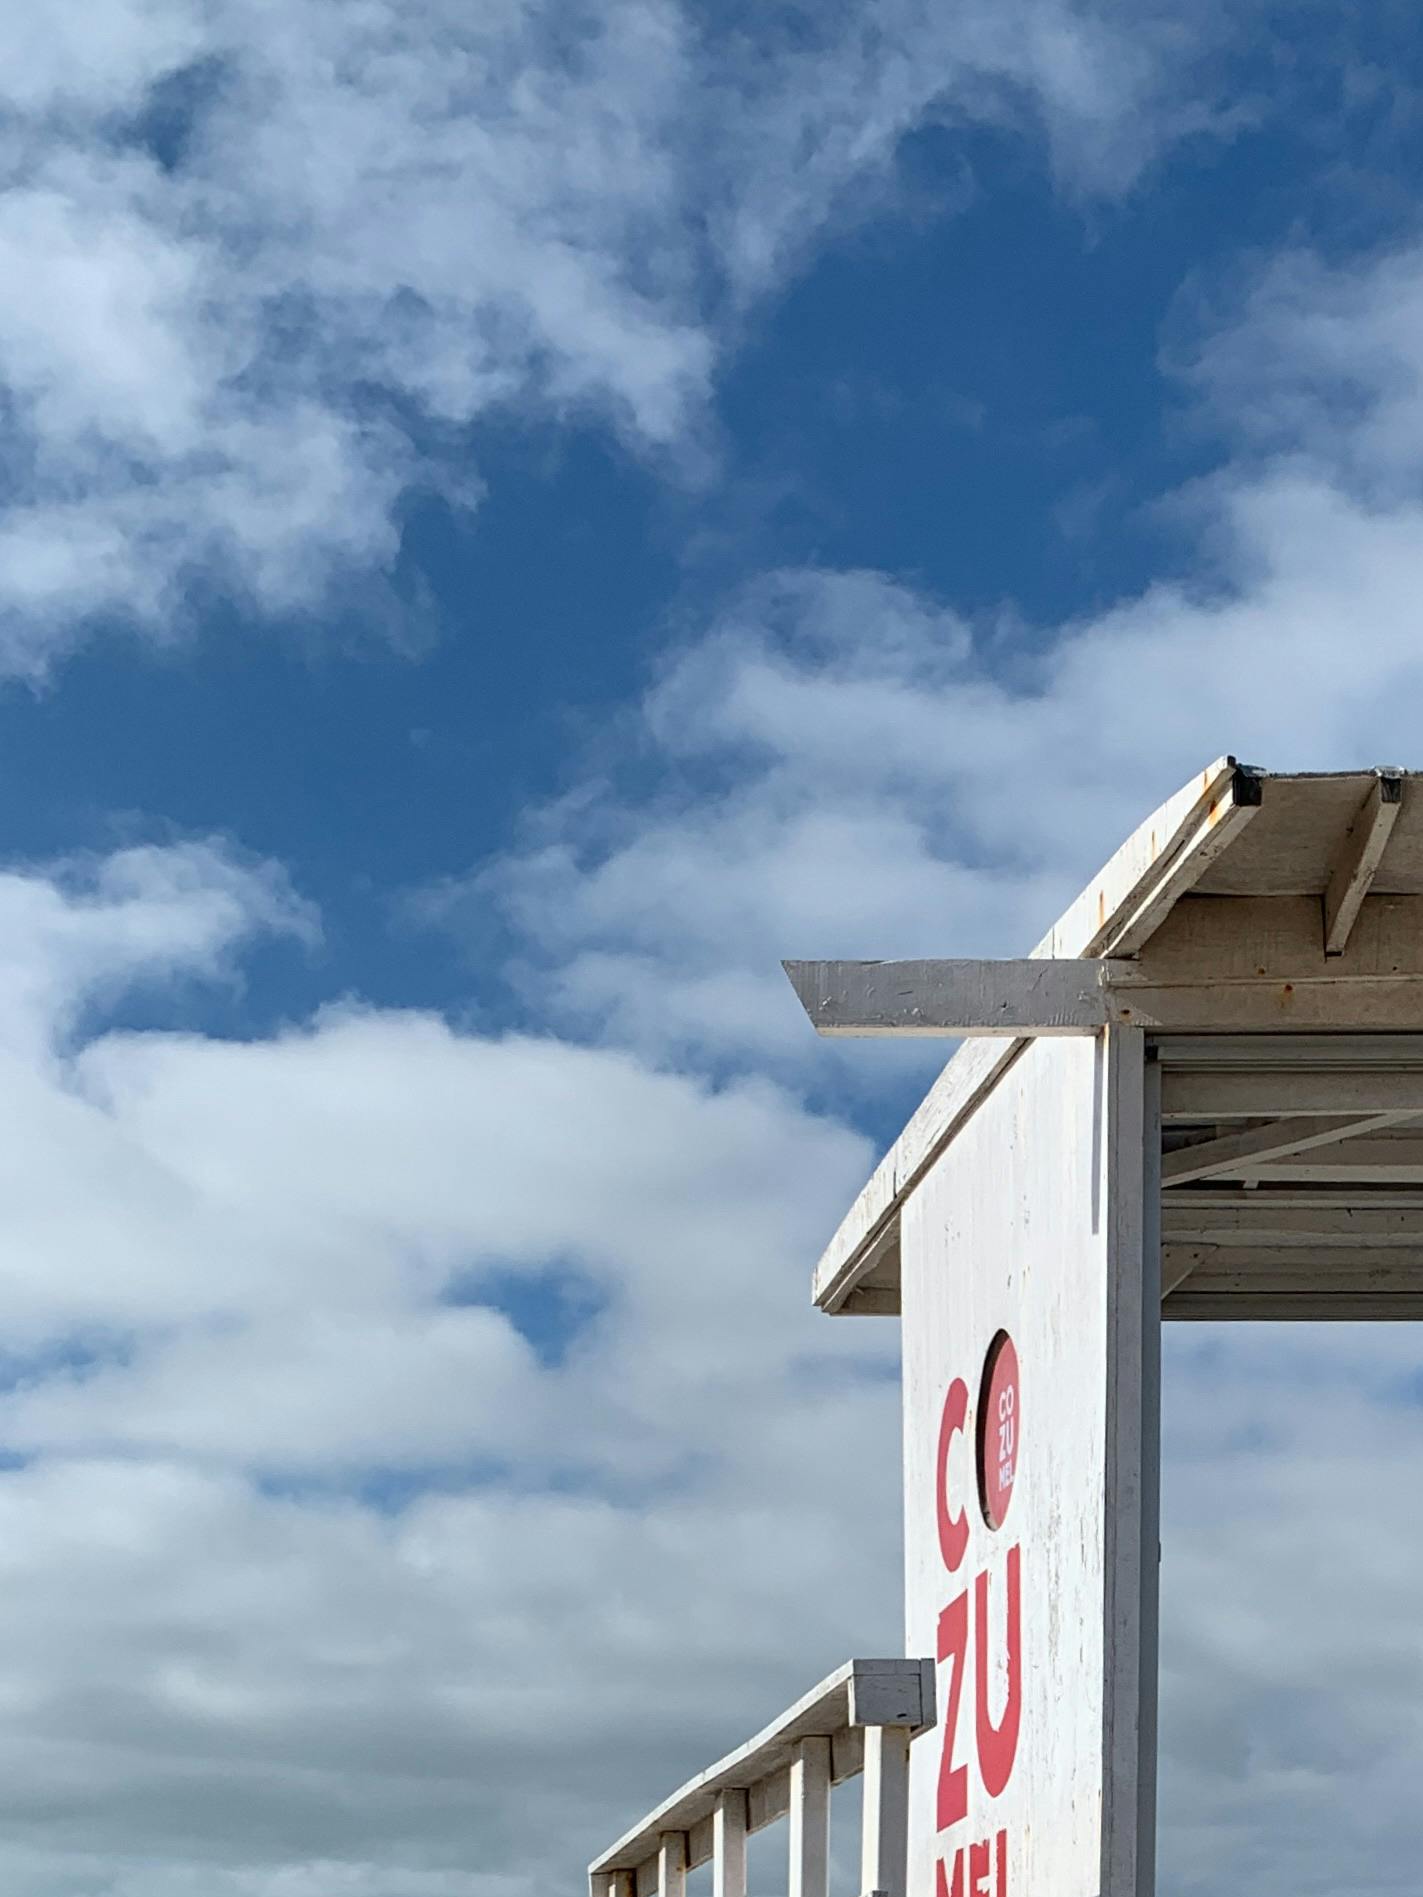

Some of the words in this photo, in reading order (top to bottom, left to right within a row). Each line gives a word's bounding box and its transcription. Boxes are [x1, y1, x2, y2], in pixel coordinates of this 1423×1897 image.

[999, 1384, 1014, 1422] CO
[999, 1416, 1014, 1462] ZU
[937, 1543, 1020, 1832] ZU
